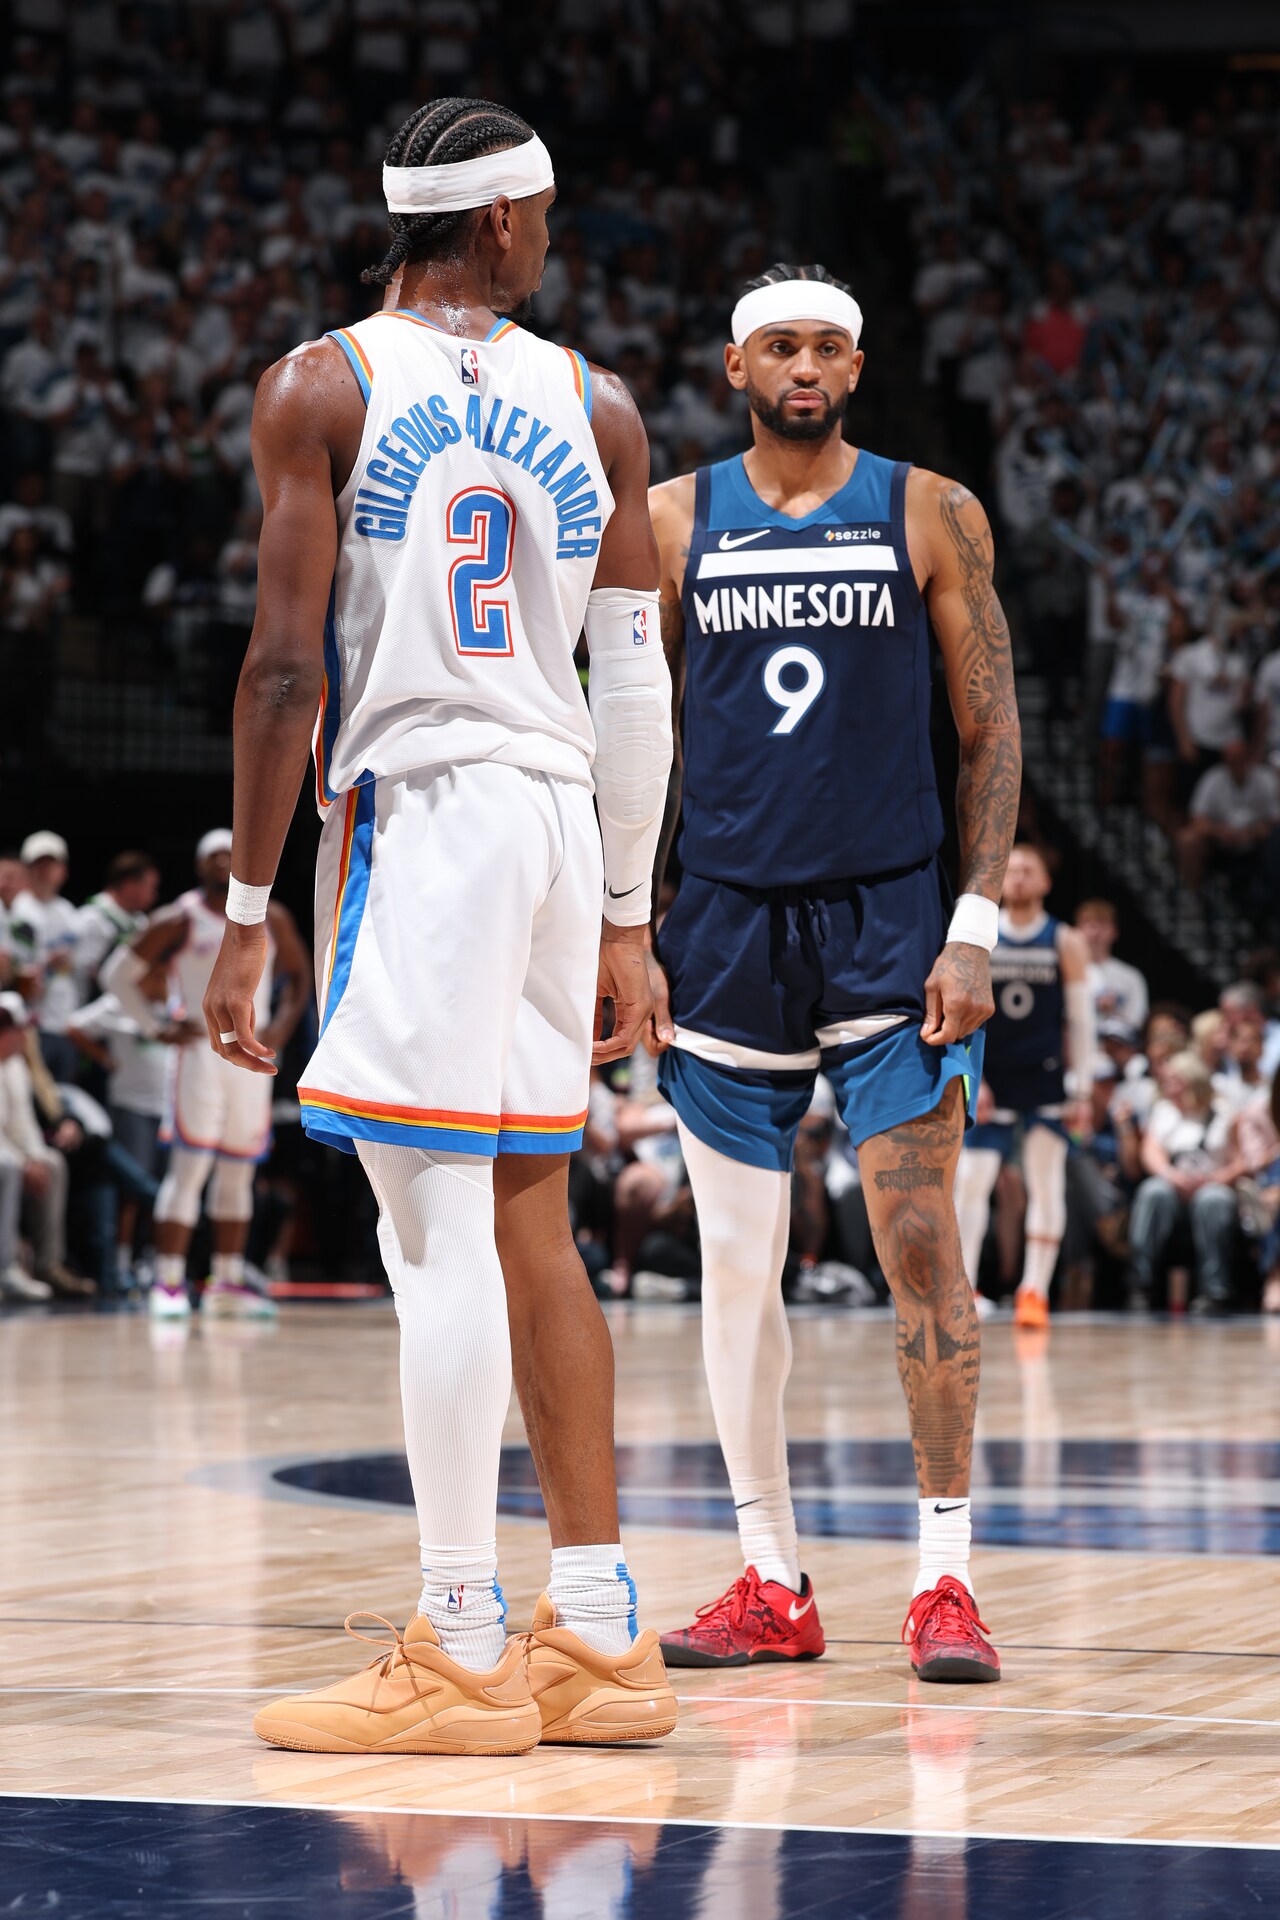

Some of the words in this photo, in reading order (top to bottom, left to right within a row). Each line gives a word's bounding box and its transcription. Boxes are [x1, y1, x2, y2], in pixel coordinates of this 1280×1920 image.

[354, 394, 462, 541] GILGEOUS
[465, 394, 602, 560] ALEXANDER
[835, 527, 882, 541] sezzle
[446, 485, 517, 658] 2
[693, 582, 895, 635] MINNESOTA
[762, 643, 827, 737] 9
[1000, 980, 1035, 1021] 0
